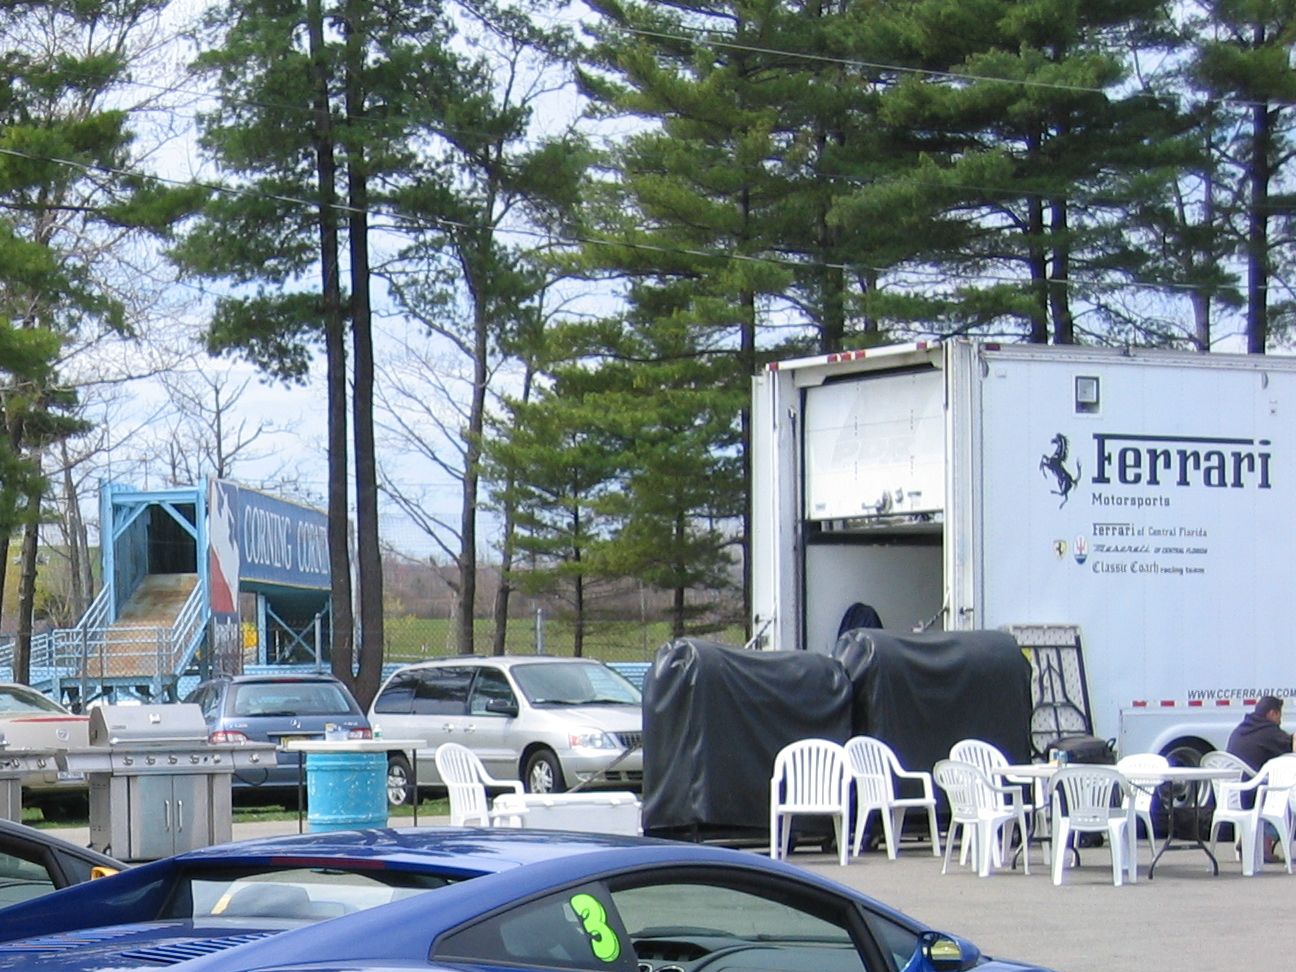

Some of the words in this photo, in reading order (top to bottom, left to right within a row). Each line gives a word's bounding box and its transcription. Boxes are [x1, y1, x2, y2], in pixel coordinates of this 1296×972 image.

[1091, 433, 1271, 488] Ferrari
[1091, 492, 1171, 509] Motorsports
[244, 505, 292, 570] CORNING
[1092, 522, 1135, 537] Ferrari
[1187, 688, 1296, 699] WWW.CCFERRARICOM
[569, 893, 621, 963] 3
